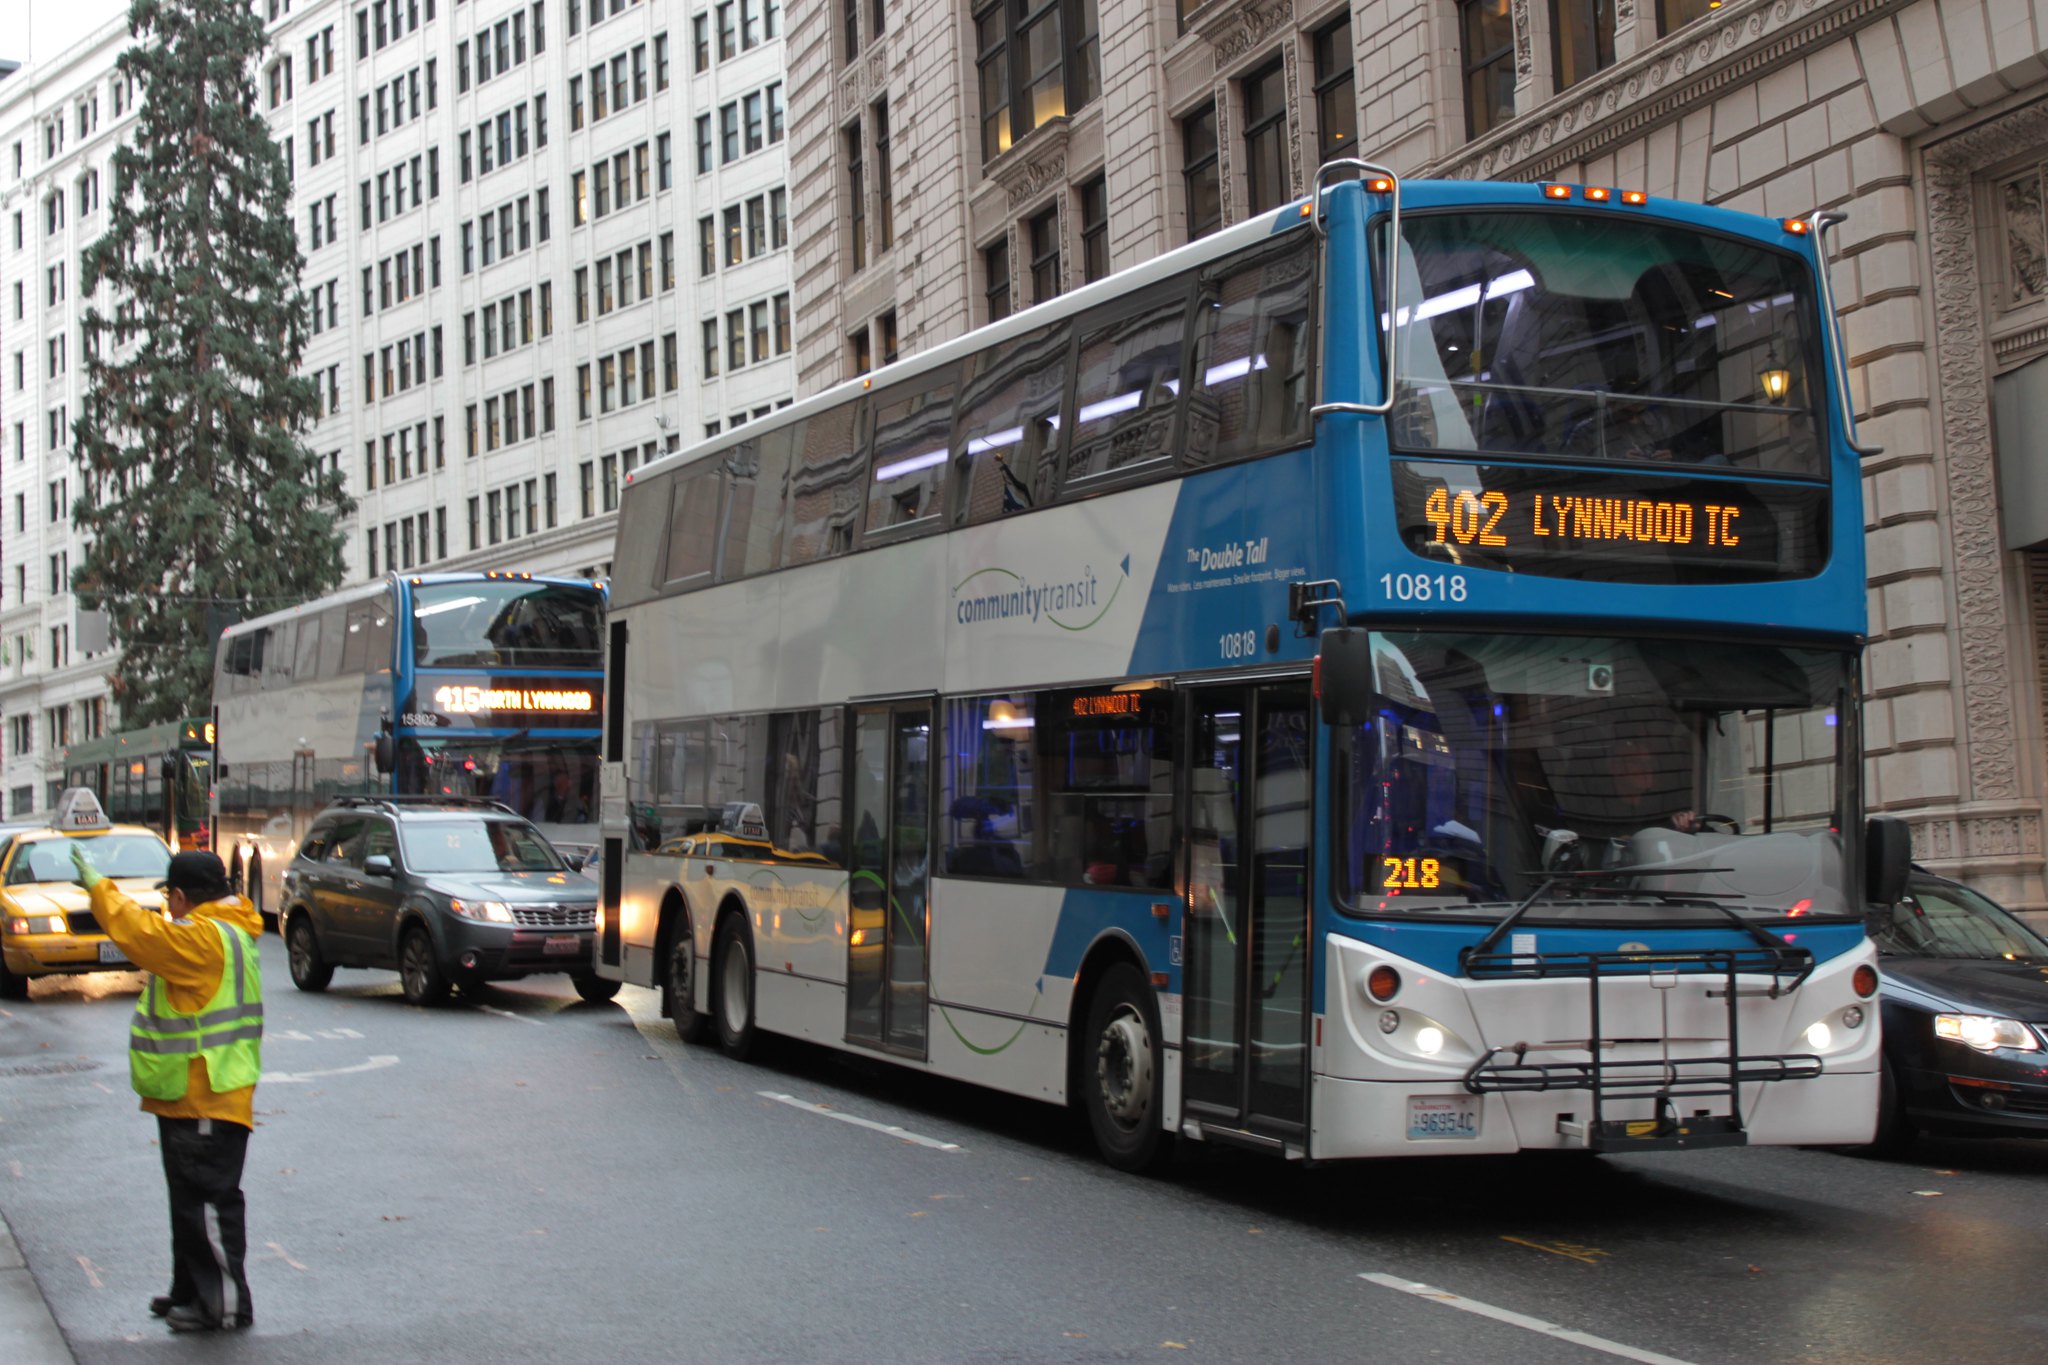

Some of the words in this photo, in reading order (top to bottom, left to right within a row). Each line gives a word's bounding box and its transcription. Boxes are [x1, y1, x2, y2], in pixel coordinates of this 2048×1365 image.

[1425, 488, 1509, 546] 402
[1534, 494, 1693, 544] LYNNWOOD
[1705, 505, 1740, 547] TC
[1187, 549, 1199, 563] The
[1200, 542, 1243, 572] Double
[1246, 537, 1268, 565] Tall
[1380, 573, 1467, 602] 10818
[1219, 630, 1255, 659] 10818
[435, 686, 480, 713] 415
[480, 690, 522, 710] NORTH
[523, 691, 592, 711] LYNNWOOD
[401, 713, 438, 727] 15802
[75, 815, 97, 824] TAXI
[1383, 857, 1440, 888] 218
